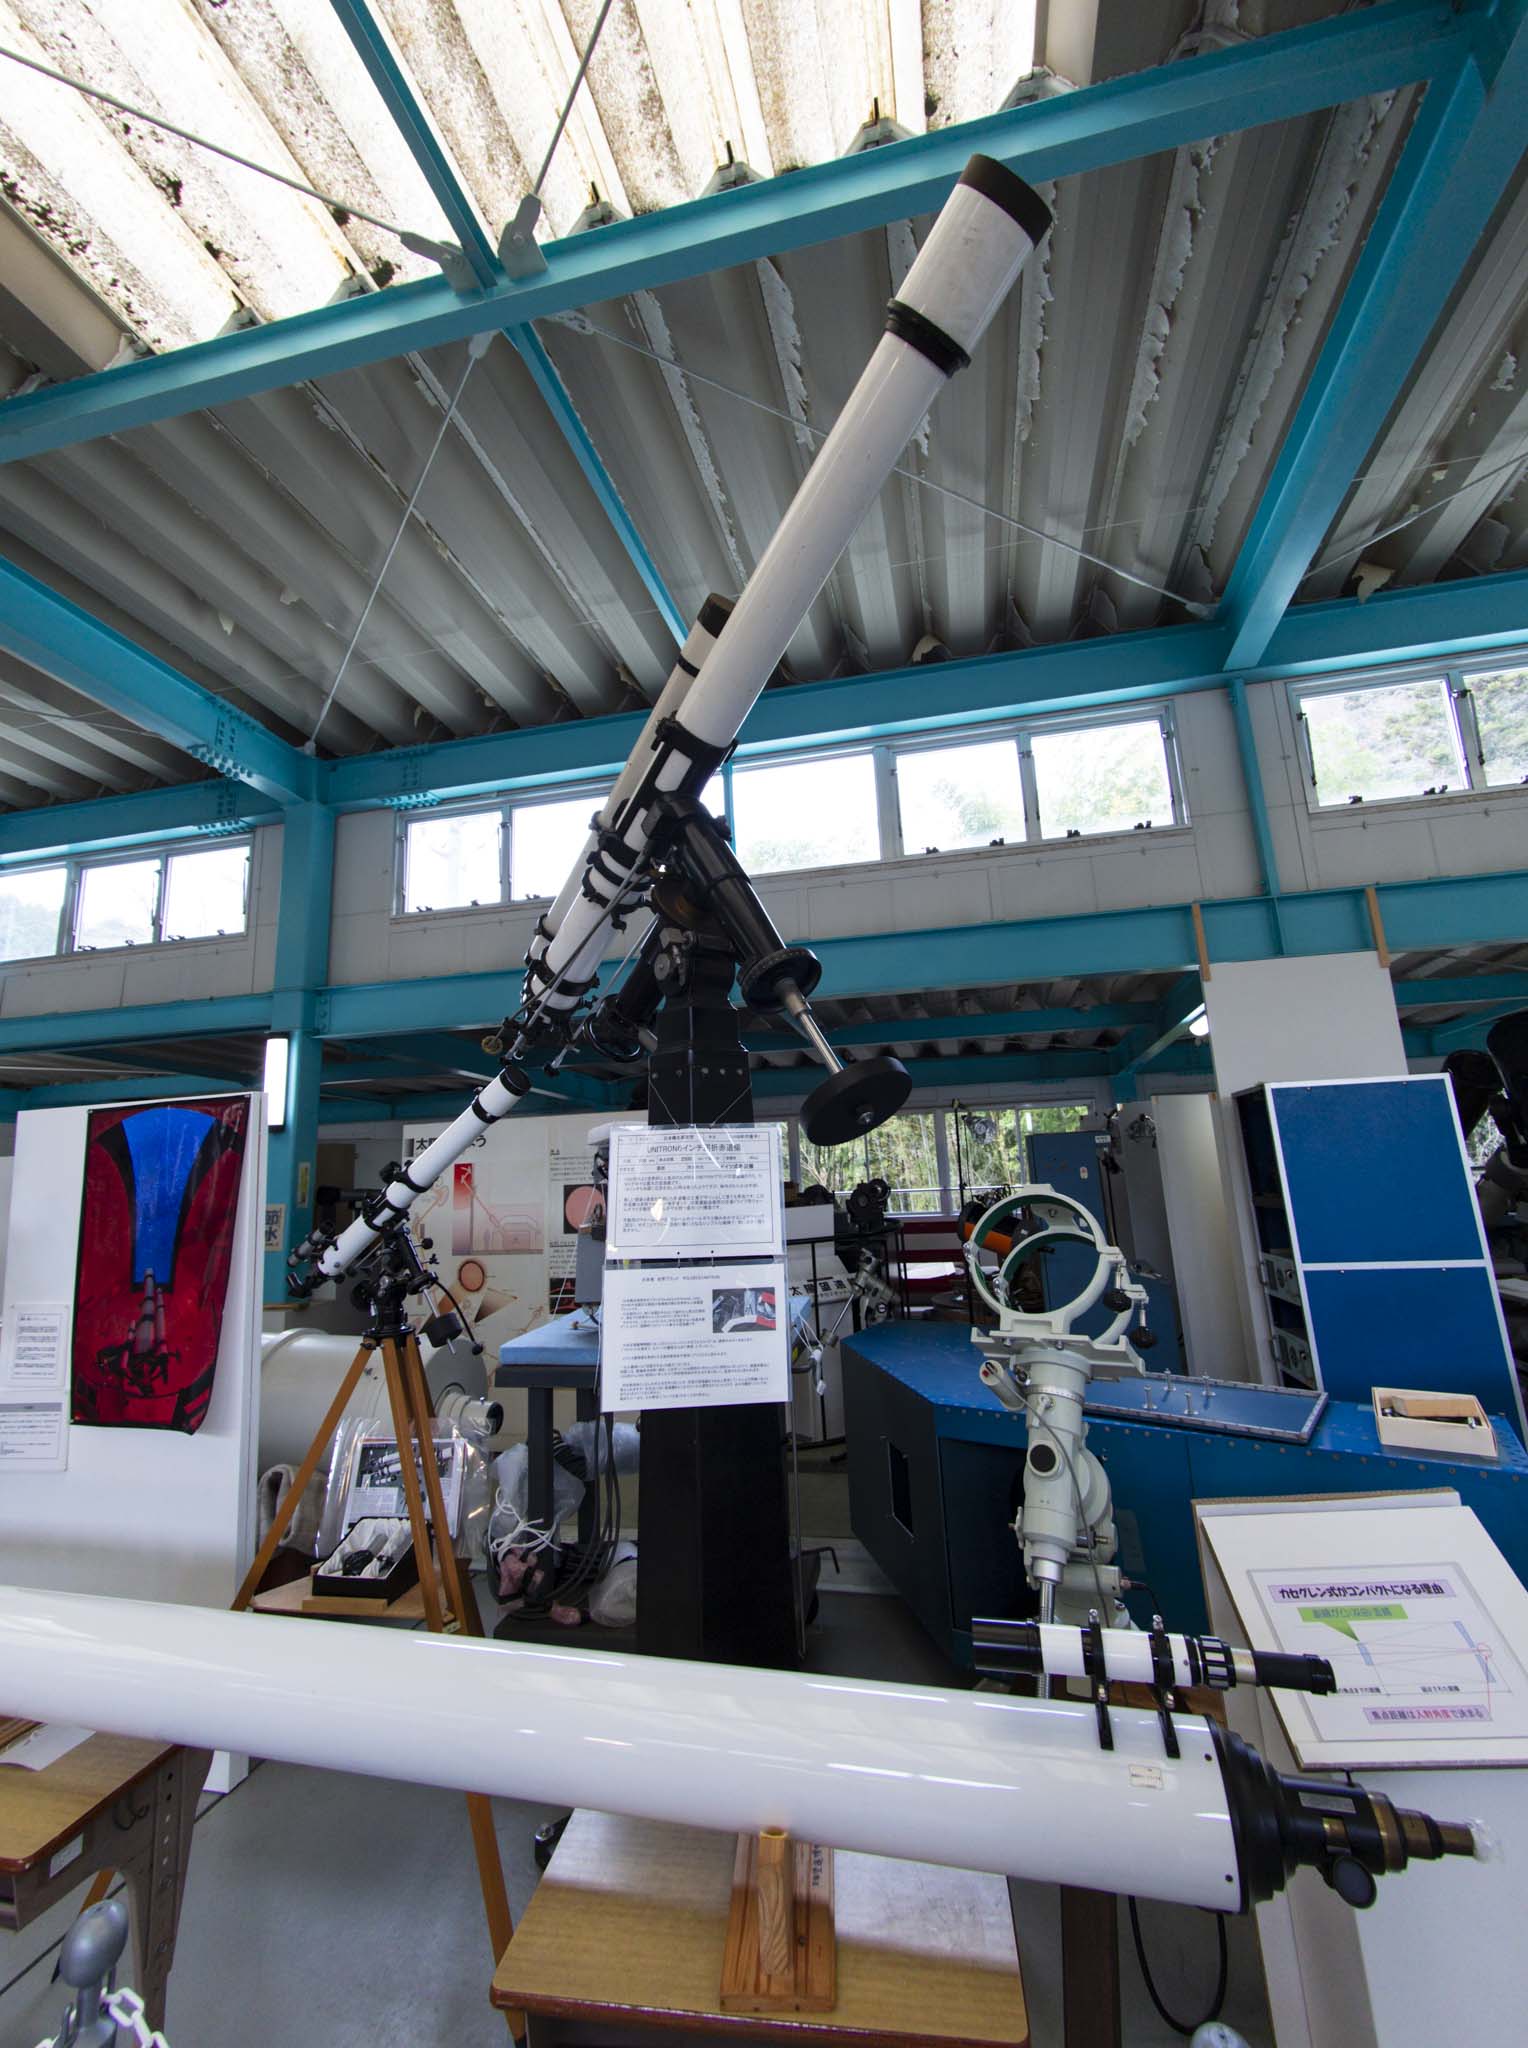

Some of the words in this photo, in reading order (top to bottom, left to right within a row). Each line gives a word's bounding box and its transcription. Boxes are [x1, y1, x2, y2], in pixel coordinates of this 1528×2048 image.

[1279, 1582, 1445, 1599] カセグレン式がコンパクトになる理由
[1371, 1707, 1484, 1721] 焦点距離は入射角度で決まる
